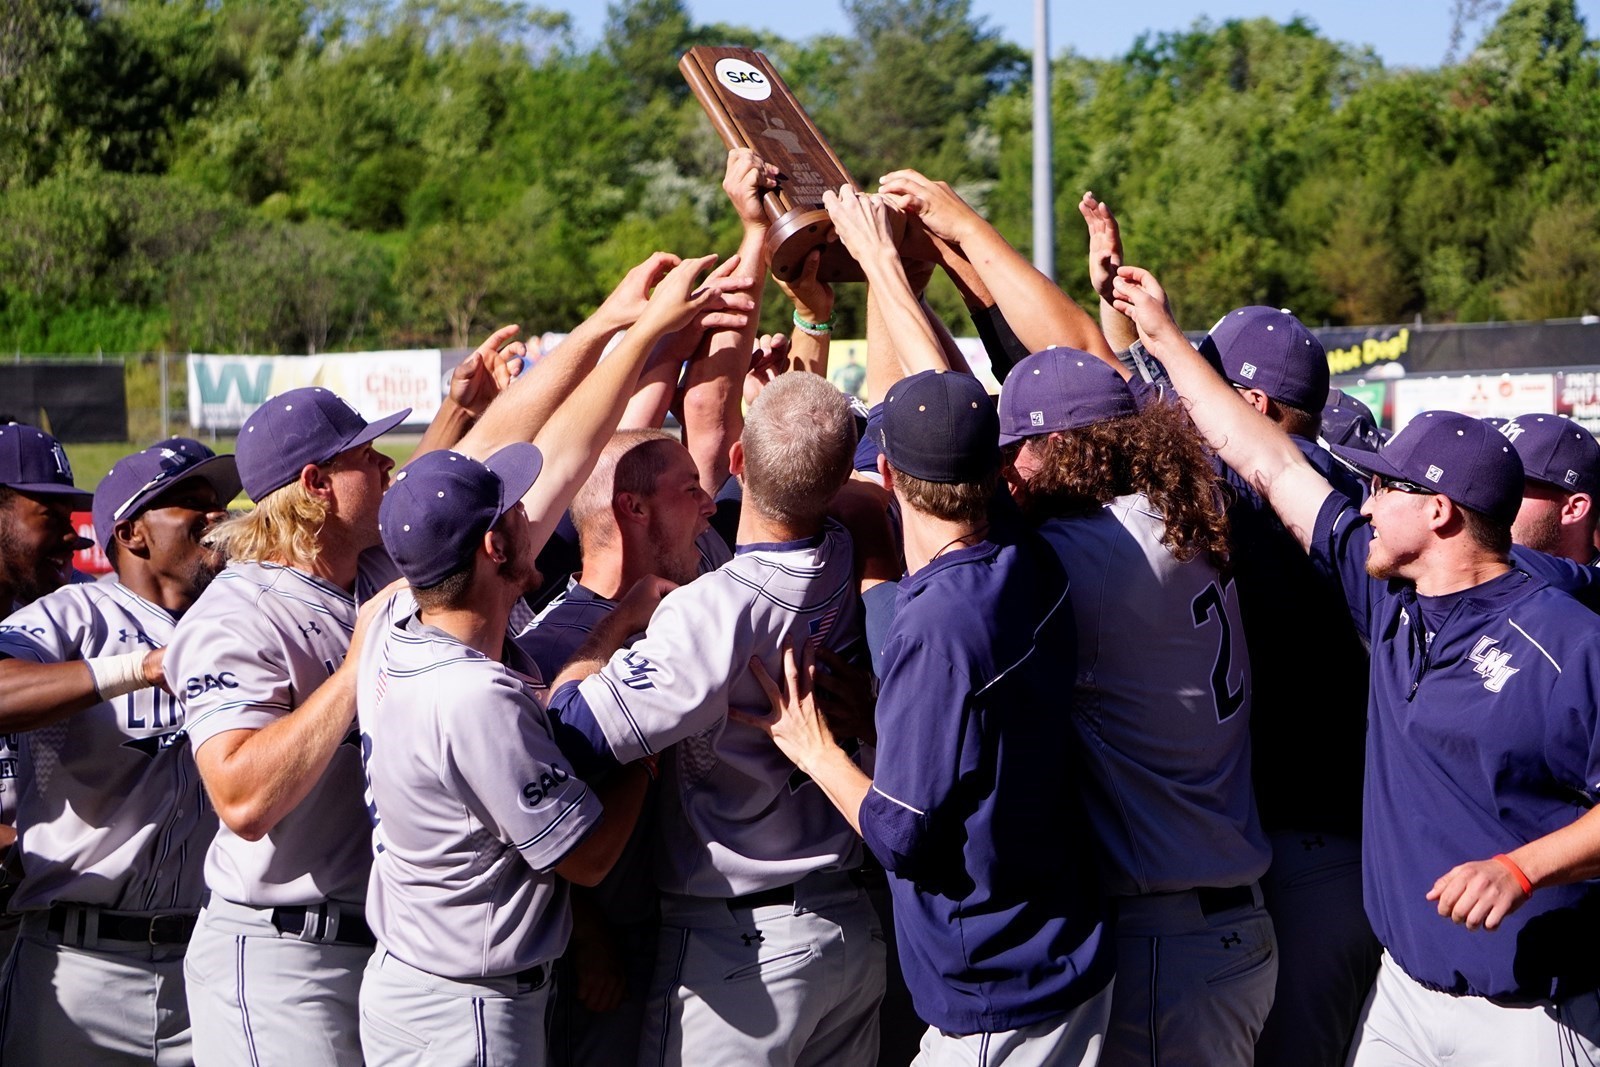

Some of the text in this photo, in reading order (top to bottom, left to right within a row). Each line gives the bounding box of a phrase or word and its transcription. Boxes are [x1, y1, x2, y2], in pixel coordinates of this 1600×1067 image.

[726, 71, 764, 83] SAC
[792, 171, 824, 184] SAC
[364, 373, 429, 396] Chop
[1466, 634, 1520, 693] LMU
[186, 671, 239, 700] SAC
[523, 763, 570, 806] SAC
